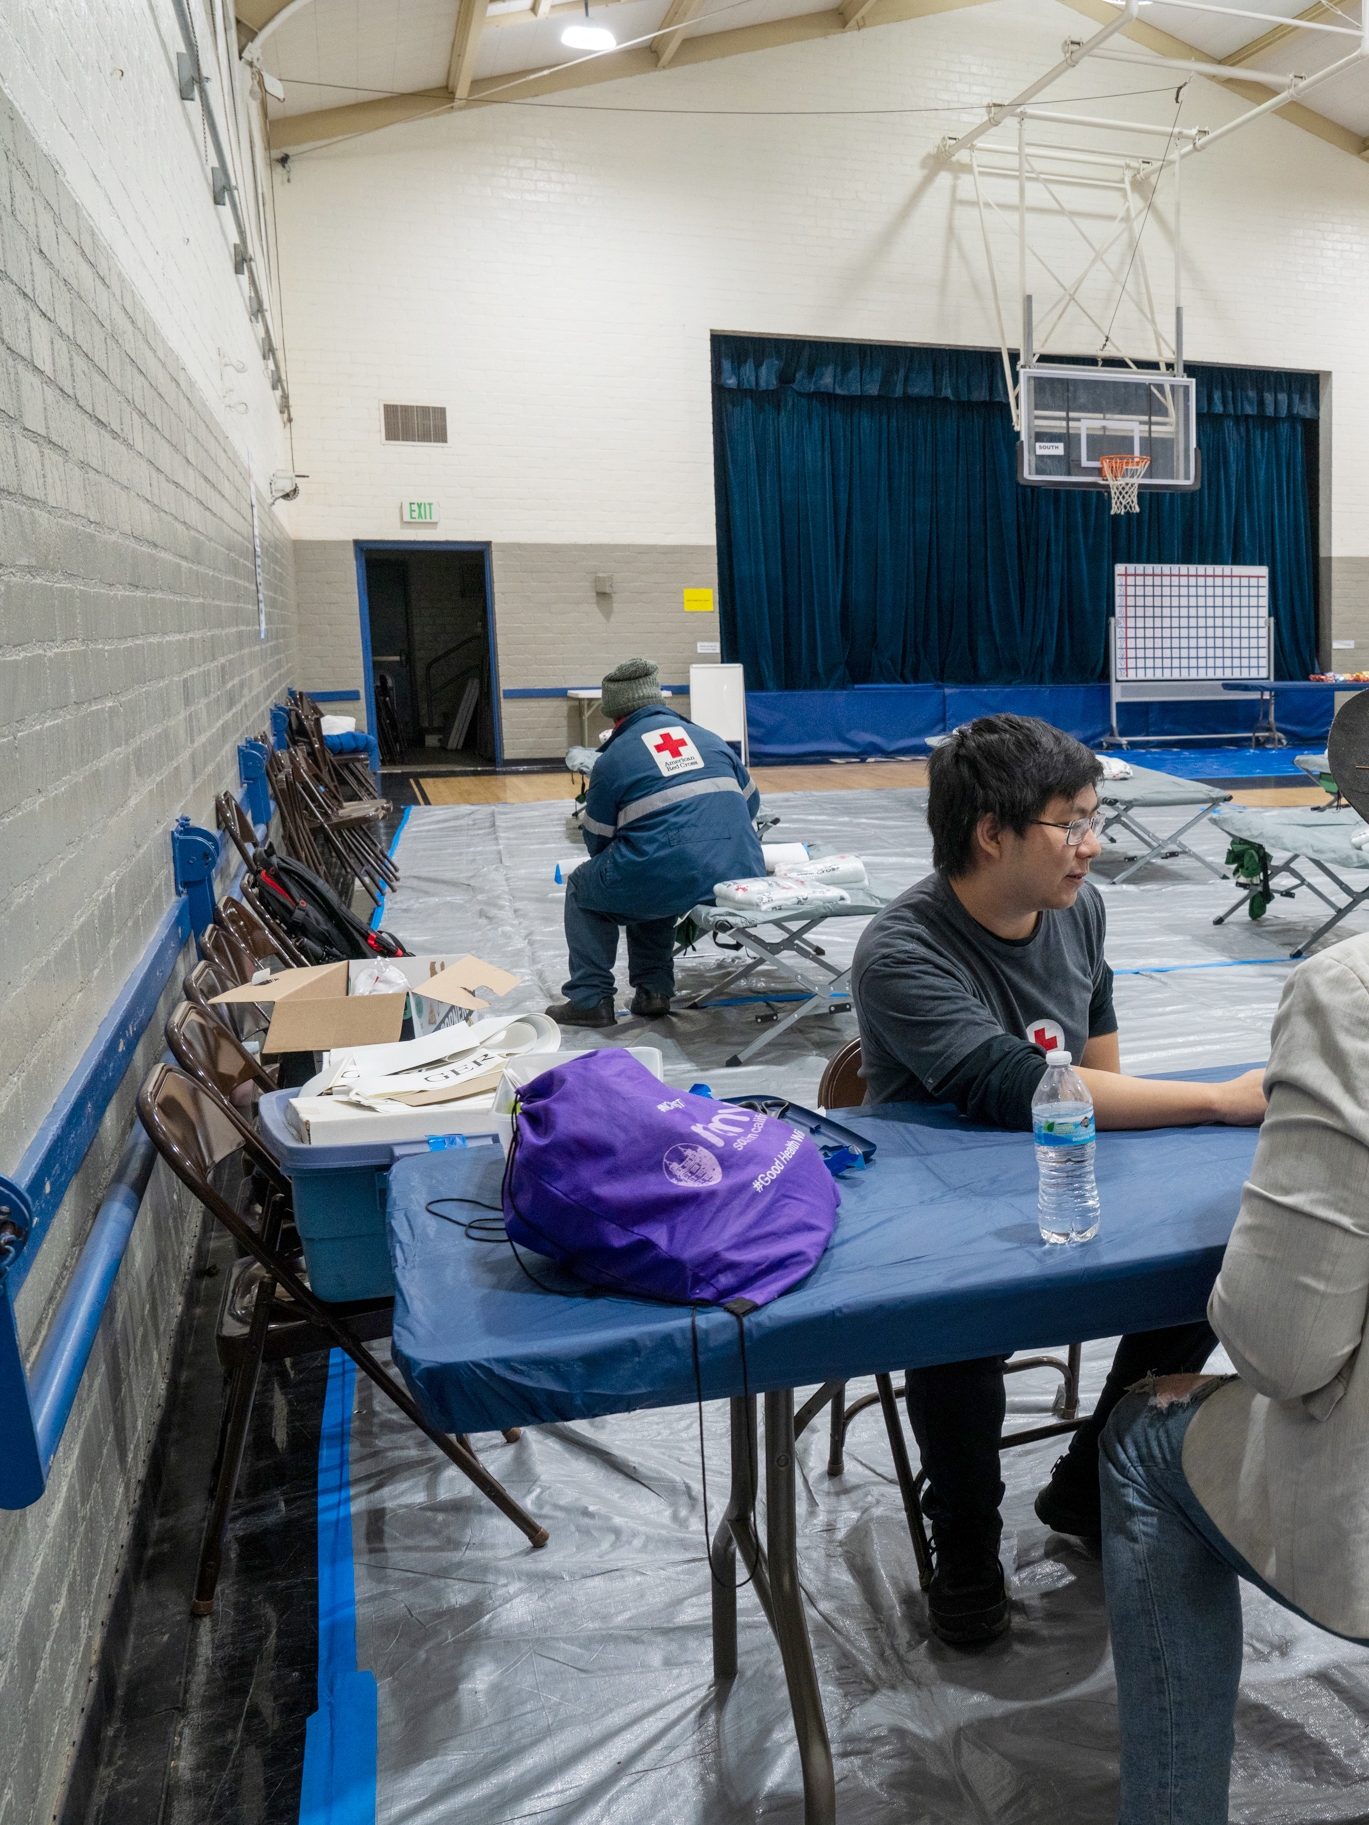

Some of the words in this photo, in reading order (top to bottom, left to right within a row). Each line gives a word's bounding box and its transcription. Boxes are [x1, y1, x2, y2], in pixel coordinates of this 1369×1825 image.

[409, 502, 433, 520] EXIT
[665, 756, 696, 767] American
[666, 764, 680, 772] Red
[680, 760, 698, 769] Cross
[423, 1053, 494, 1083] GER
[752, 1158, 785, 1193] #Good
[777, 1141, 801, 1164] Health
